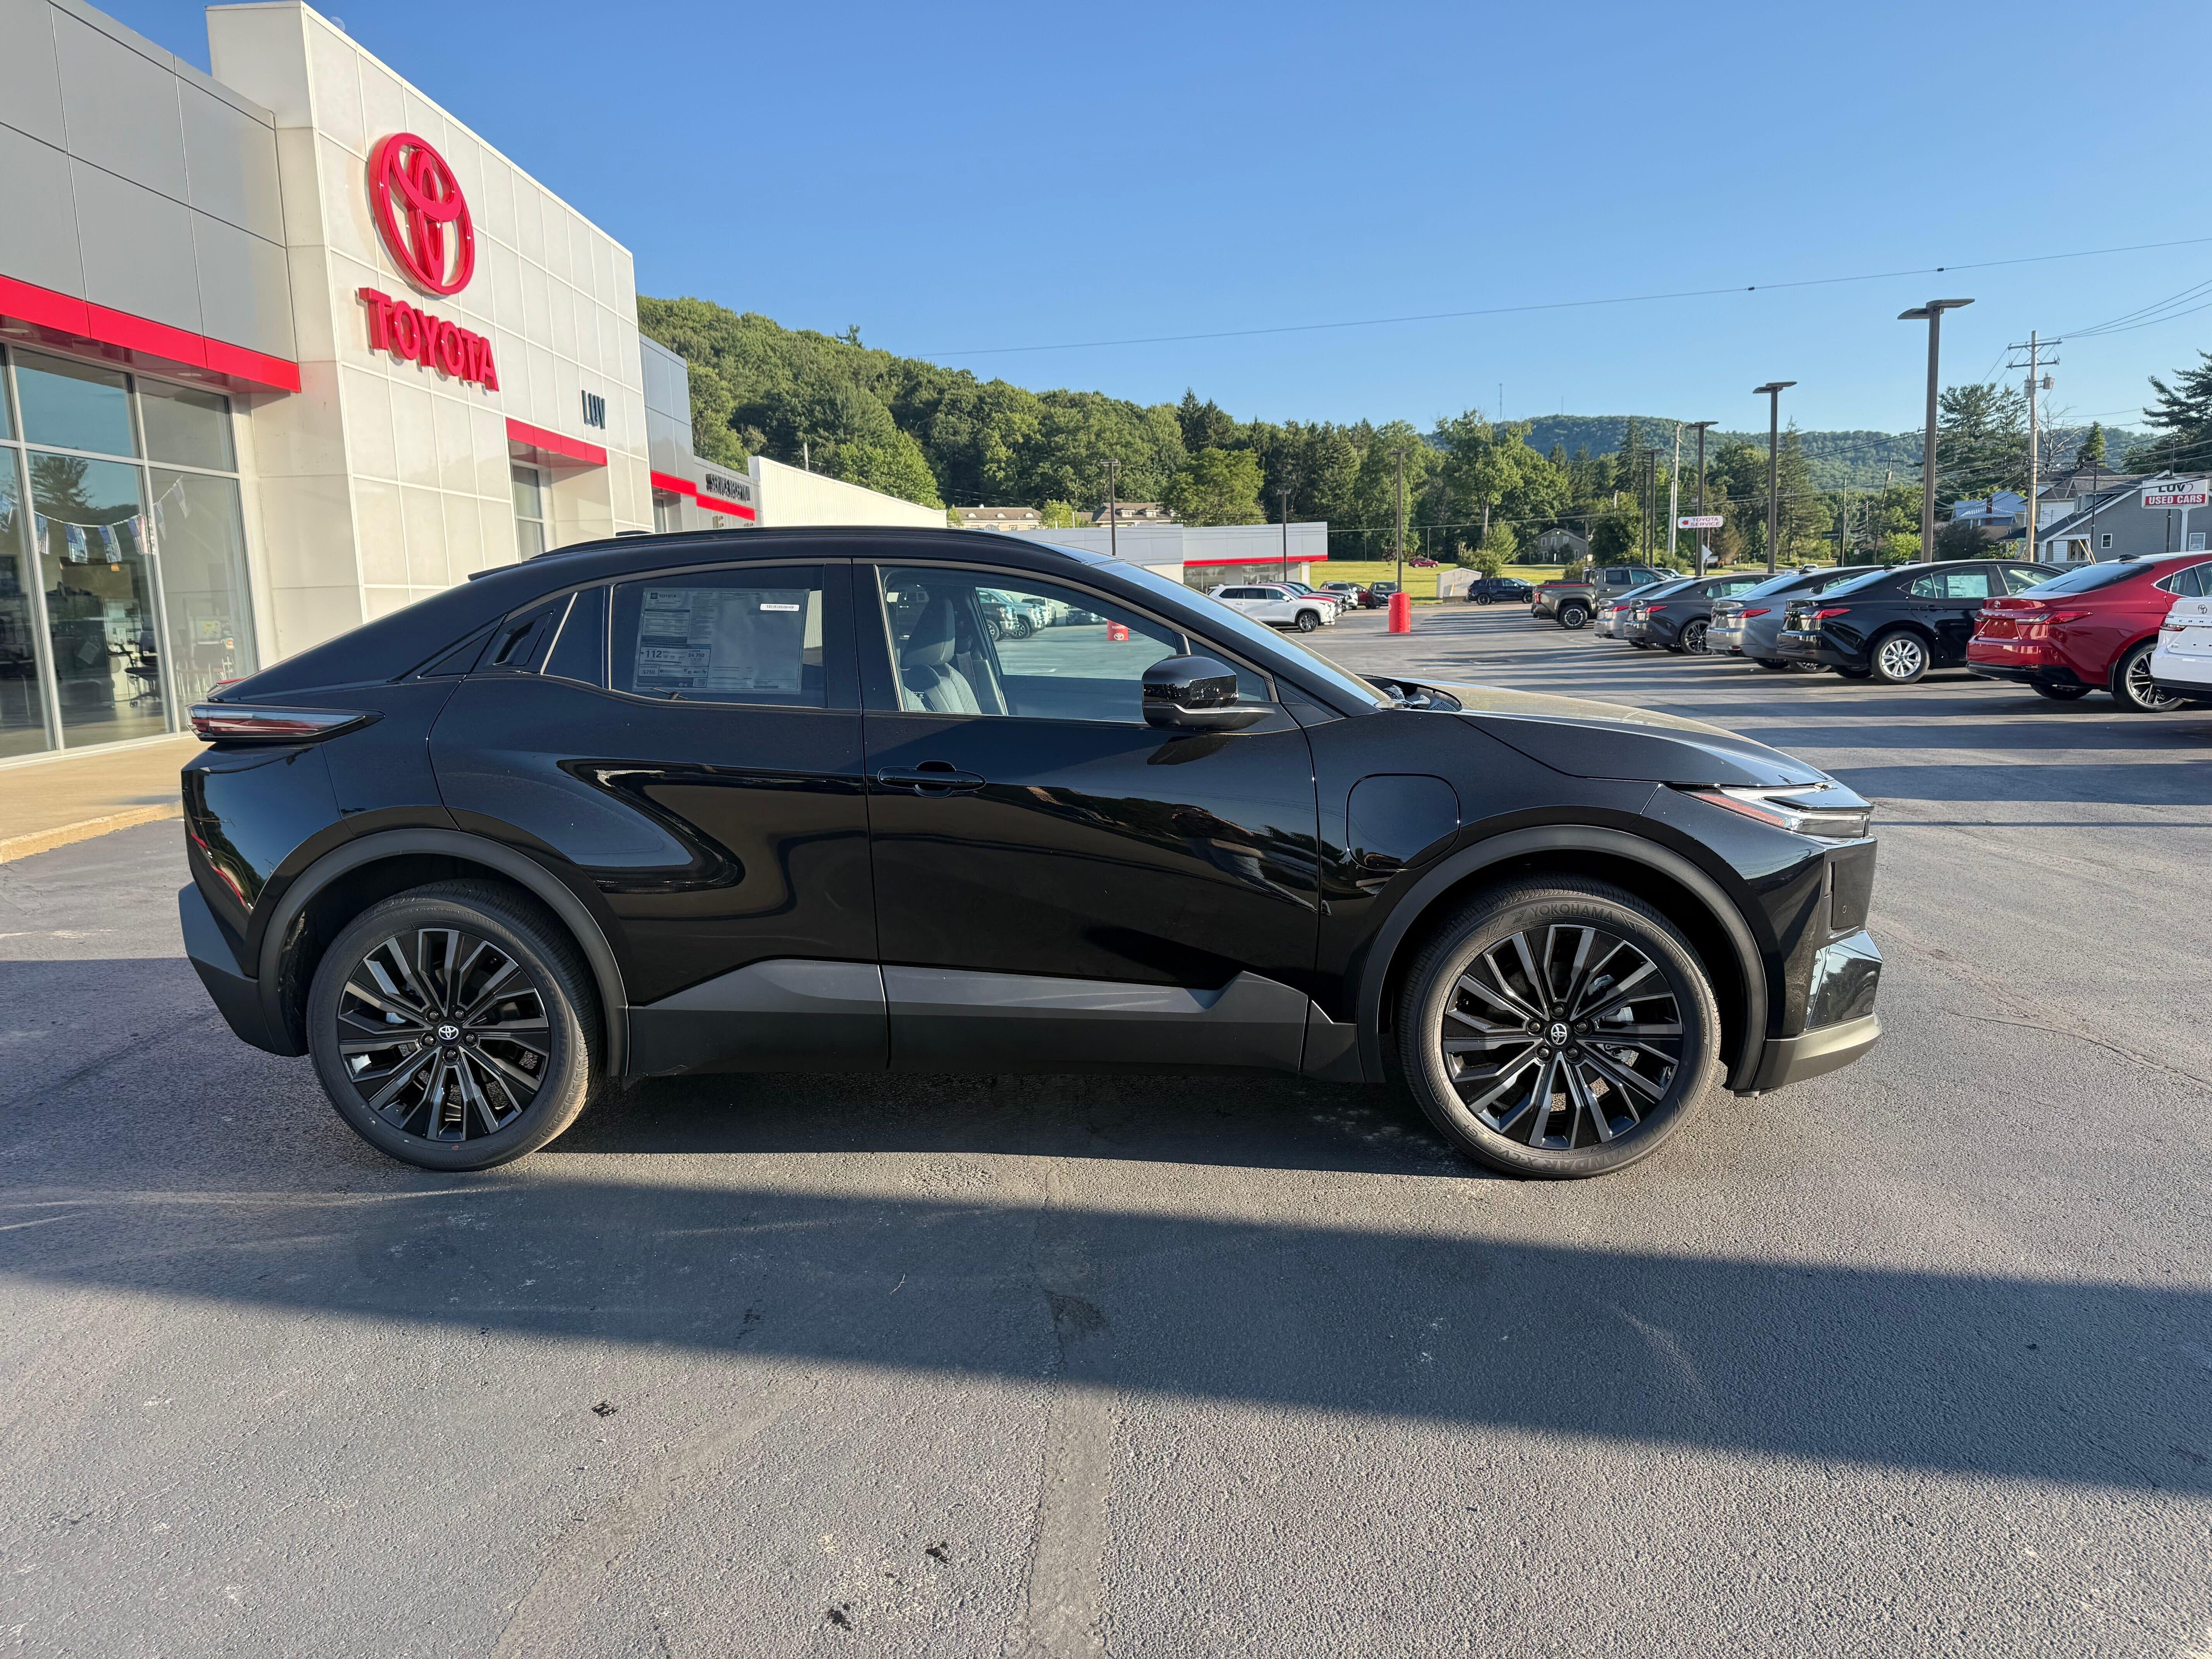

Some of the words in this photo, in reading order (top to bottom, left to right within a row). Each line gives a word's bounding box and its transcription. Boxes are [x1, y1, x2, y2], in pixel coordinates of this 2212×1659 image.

[359, 287, 499, 392] TOYOTA
[581, 390, 605, 430] LUV
[2159, 484, 2185, 493] LUV
[2149, 496, 2174, 505] USED
[2177, 495, 2202, 503] CARS
[1530, 903, 1613, 922] YOKOHAMA
[1488, 1141, 1502, 1151] G057
[1498, 1149, 1538, 1167] X-CV
